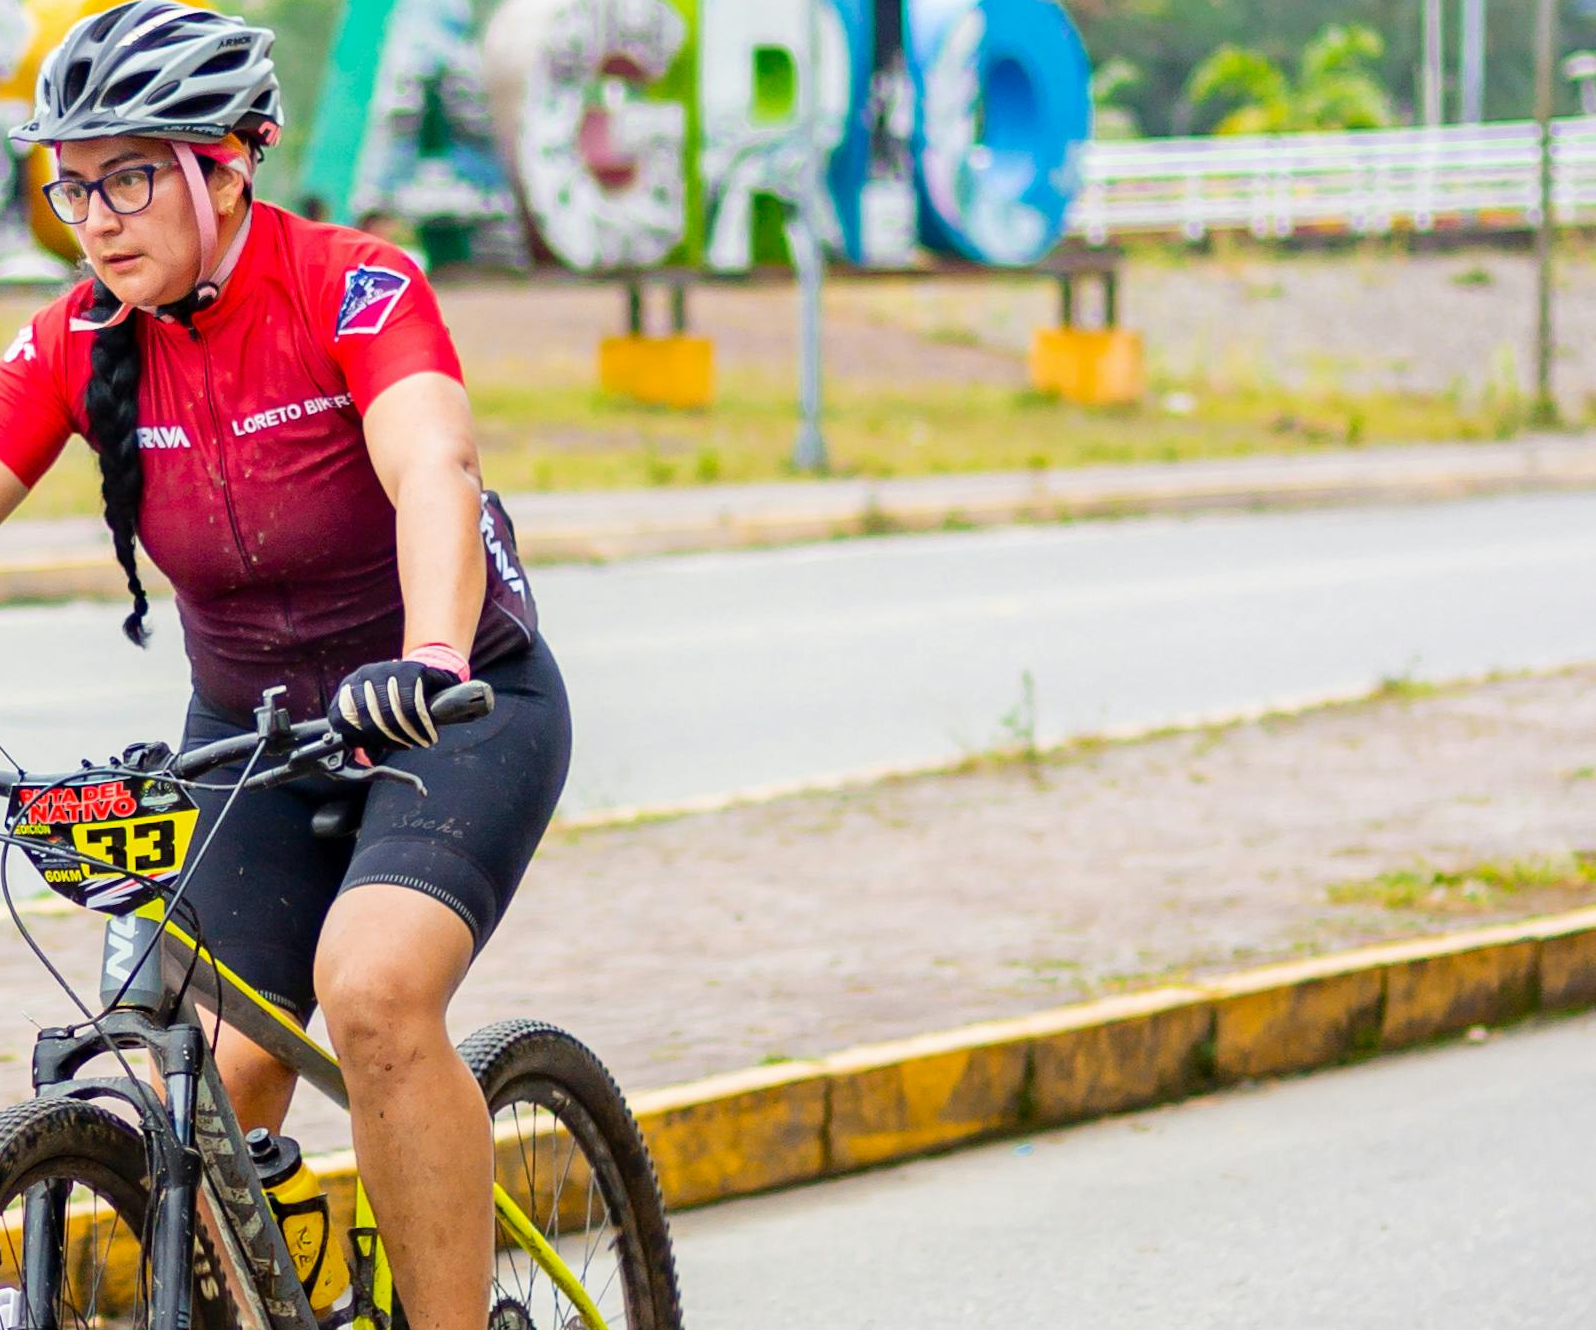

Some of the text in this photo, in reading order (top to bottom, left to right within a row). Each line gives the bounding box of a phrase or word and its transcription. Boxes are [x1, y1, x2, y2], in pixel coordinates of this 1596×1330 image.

[231, 403, 302, 437] LORETO
[136, 425, 192, 449] RAVA
[81, 781, 131, 803] DEL
[28, 796, 137, 825] NATIVO
[86, 820, 175, 875] 33
[45, 869, 83, 883] 60KM
